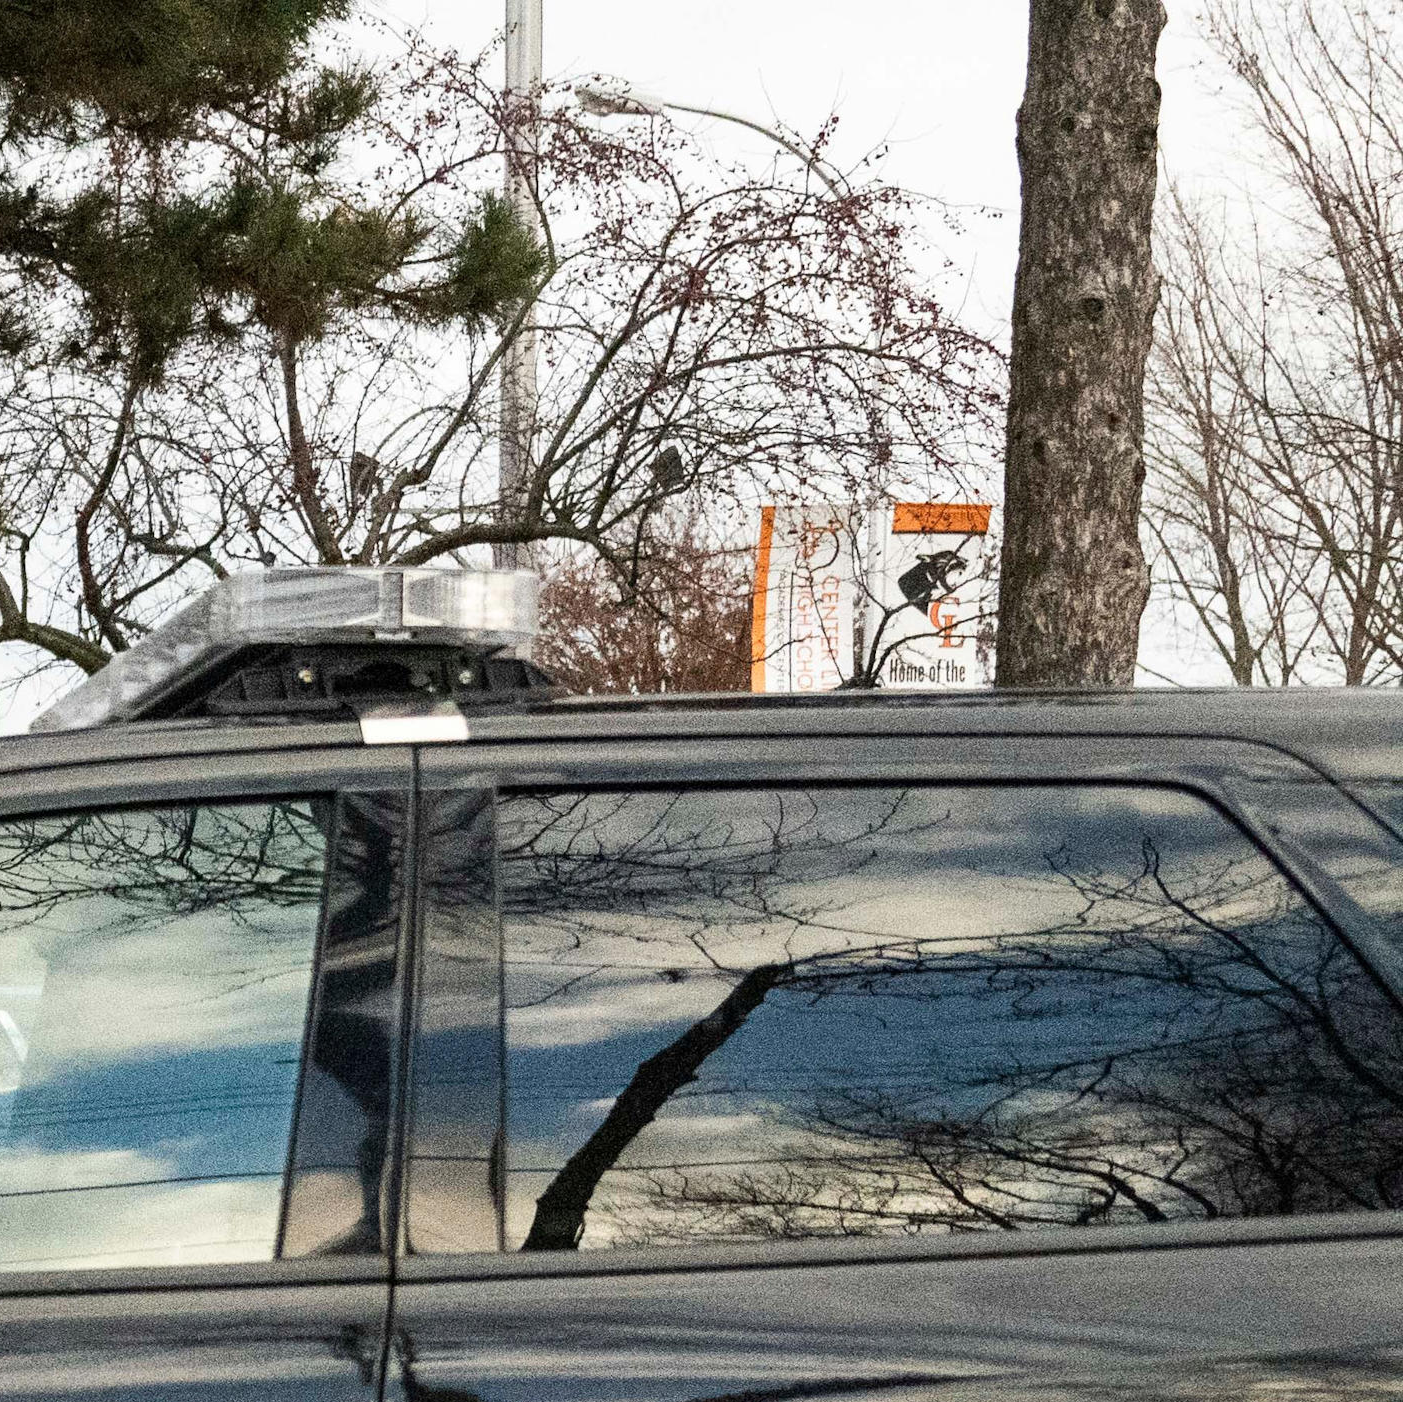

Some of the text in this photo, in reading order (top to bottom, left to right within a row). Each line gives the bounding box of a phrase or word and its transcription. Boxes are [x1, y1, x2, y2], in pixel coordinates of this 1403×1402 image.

[819, 575, 841, 661] CENTER
[889, 659, 966, 684] Home of the
